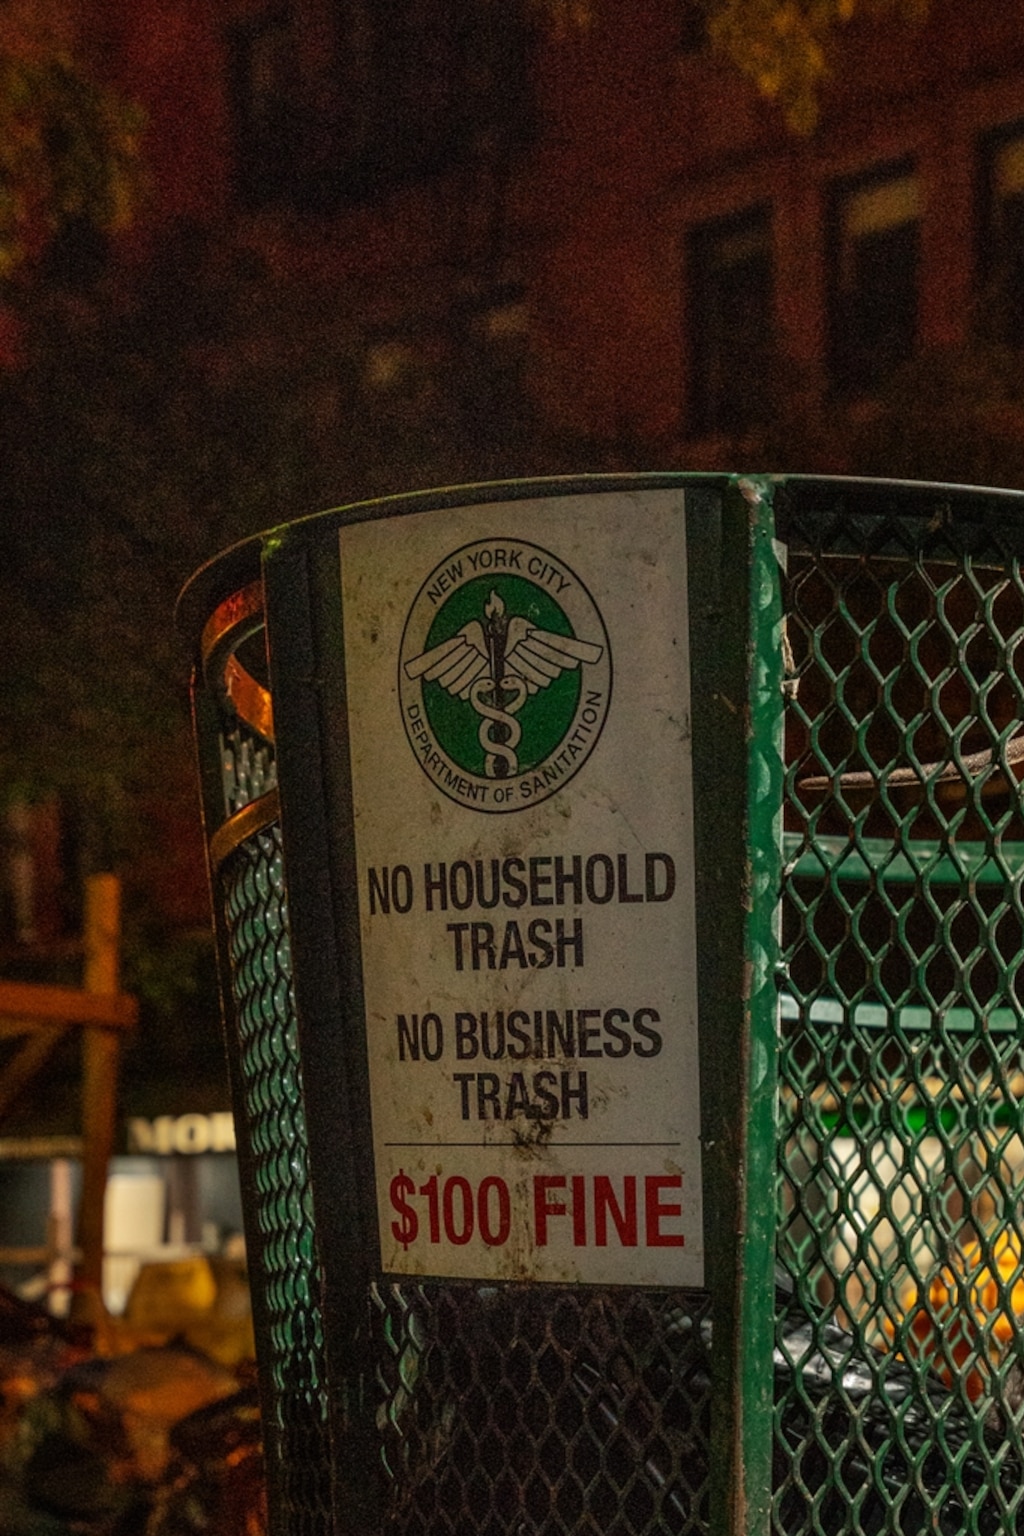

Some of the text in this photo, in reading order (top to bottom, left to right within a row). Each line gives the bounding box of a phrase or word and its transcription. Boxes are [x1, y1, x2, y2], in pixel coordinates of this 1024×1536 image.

[427, 549, 572, 605] NEW YORK CITY
[406, 690, 602, 803] DEPARTMENT OF SANITATION
[368, 852, 677, 915] NO HOUSEHOLD
[447, 918, 584, 971] TRASH
[397, 1007, 663, 1061] NO BUSINESS
[453, 1070, 589, 1121] TRASH
[389, 1168, 685, 1251] $100 FINE
